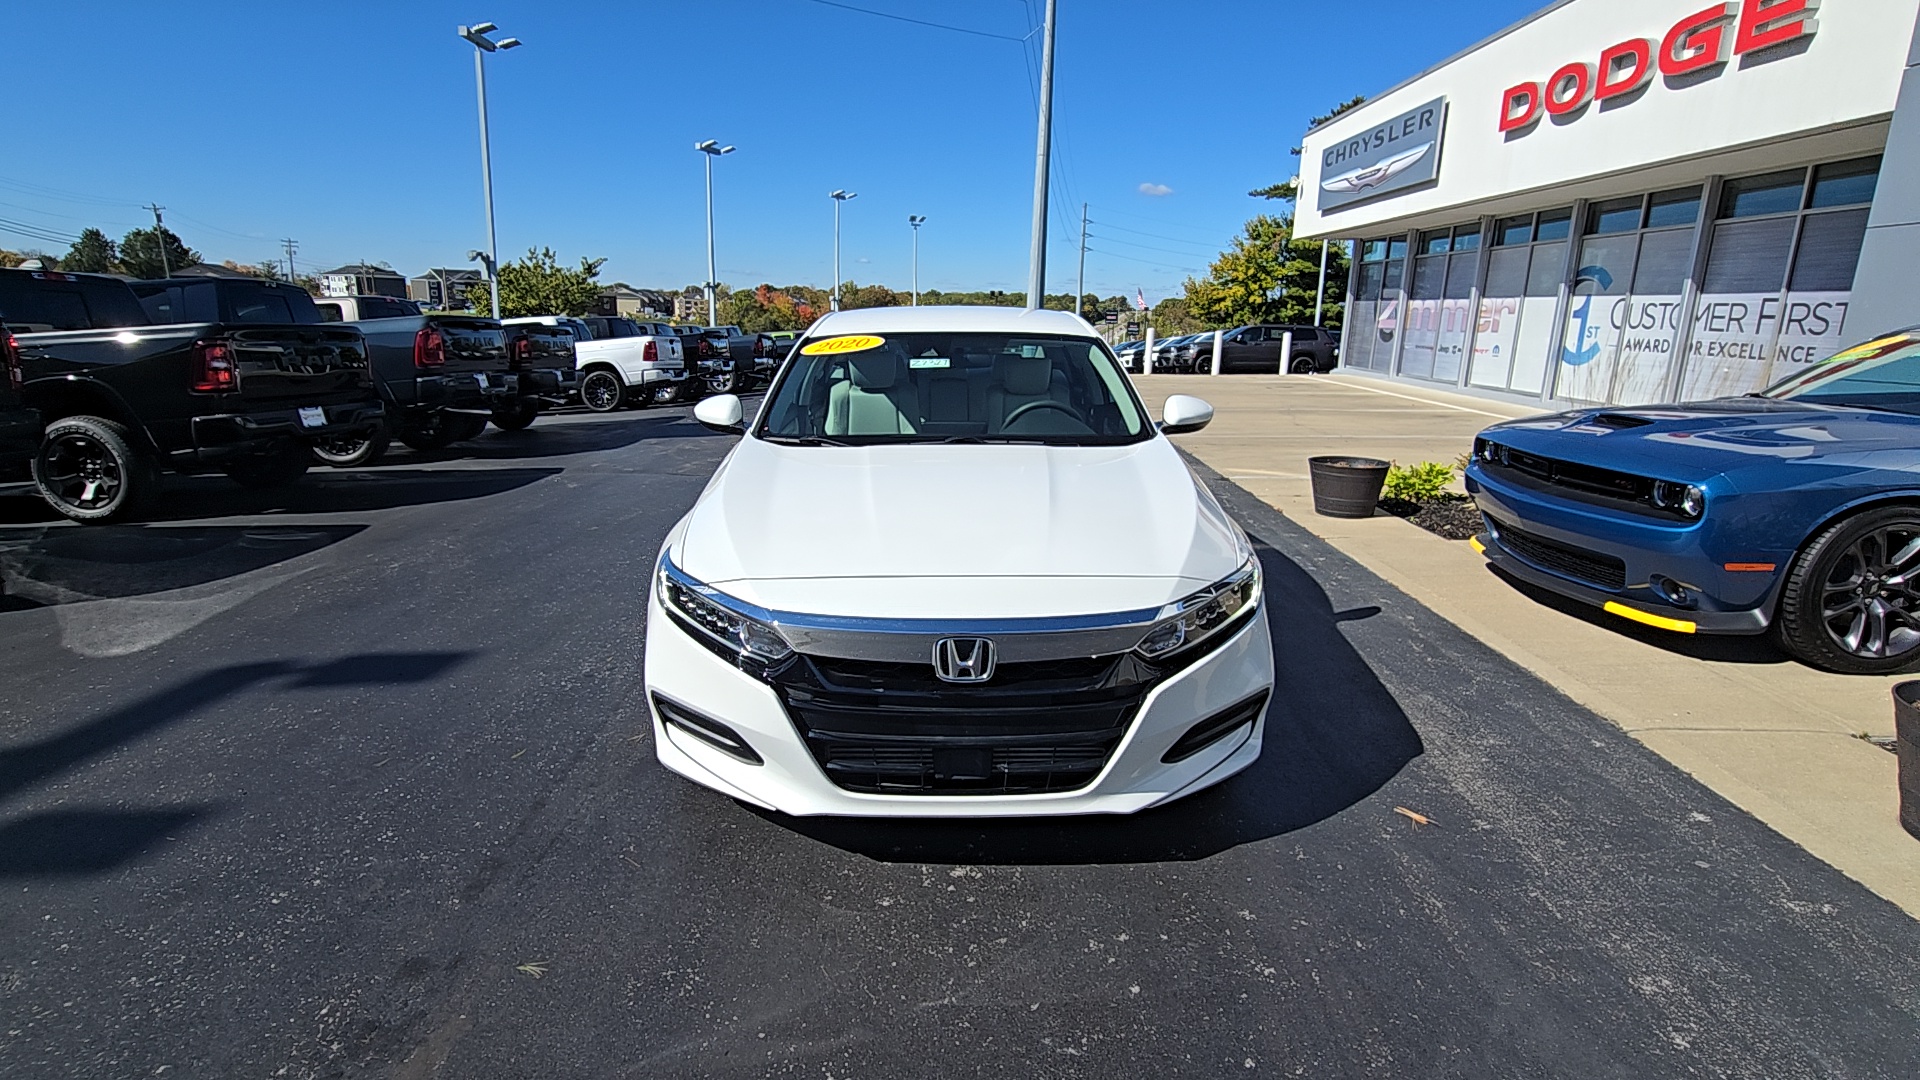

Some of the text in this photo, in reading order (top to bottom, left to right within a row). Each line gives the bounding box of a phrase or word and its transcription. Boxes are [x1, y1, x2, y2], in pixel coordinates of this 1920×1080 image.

[1498, 0, 1812, 132] DODGE
[1325, 108, 1434, 167] CHRYSLER
[1377, 296, 1516, 333] Zmmer
[1755, 297, 1849, 336] FIRST
[814, 338, 871, 352] 2020
[1624, 339, 1670, 353] AWARD
[1707, 342, 1816, 363] EXCELLNCE
